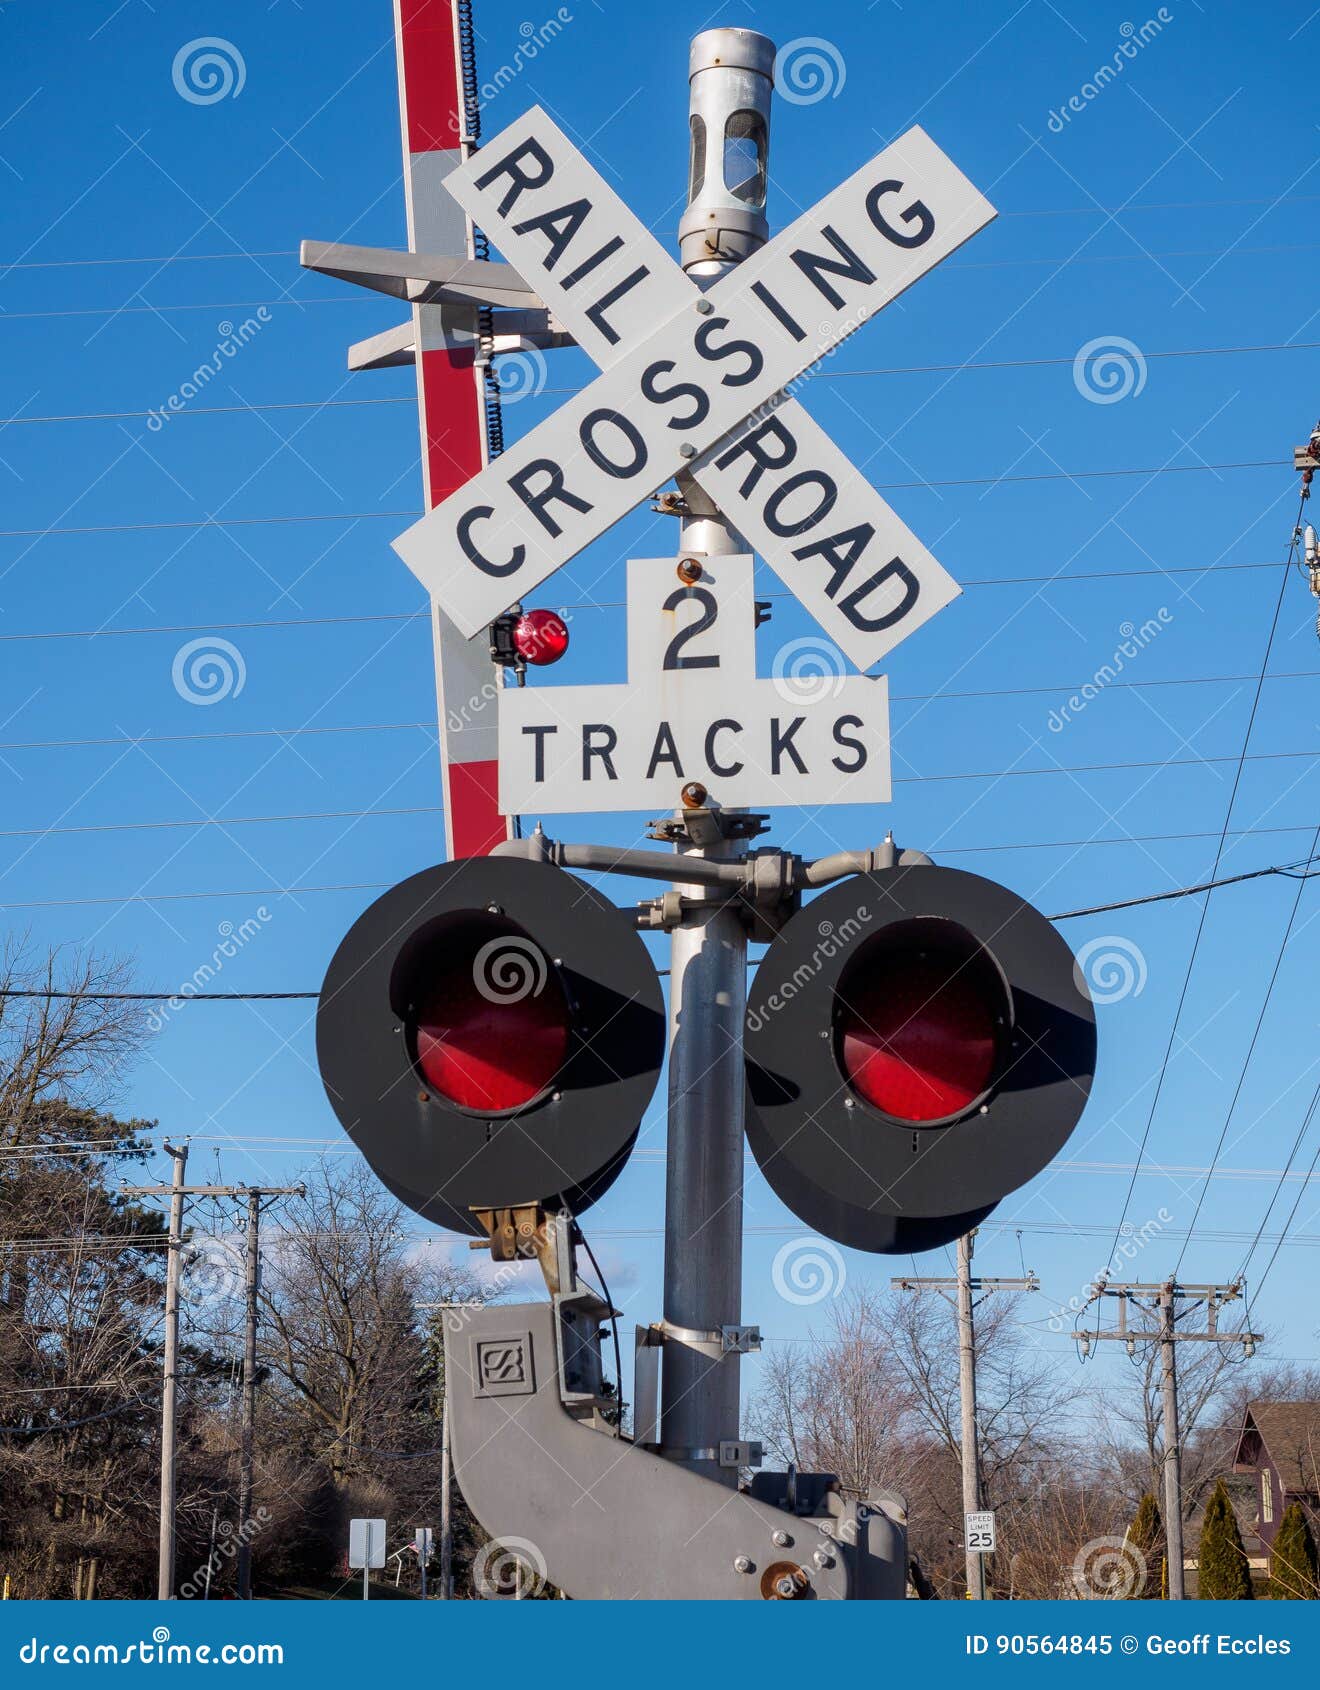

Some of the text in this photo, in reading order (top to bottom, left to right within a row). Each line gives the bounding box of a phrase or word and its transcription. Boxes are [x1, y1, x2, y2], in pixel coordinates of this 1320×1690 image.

[474, 135, 651, 346] RAIL
[456, 179, 936, 578] CROSSING
[714, 414, 920, 633] ROAD
[662, 586, 721, 671] 2
[521, 714, 868, 783] TRACKS
[967, 1514, 992, 1522] SPEED
[968, 1533, 993, 1547] 25
